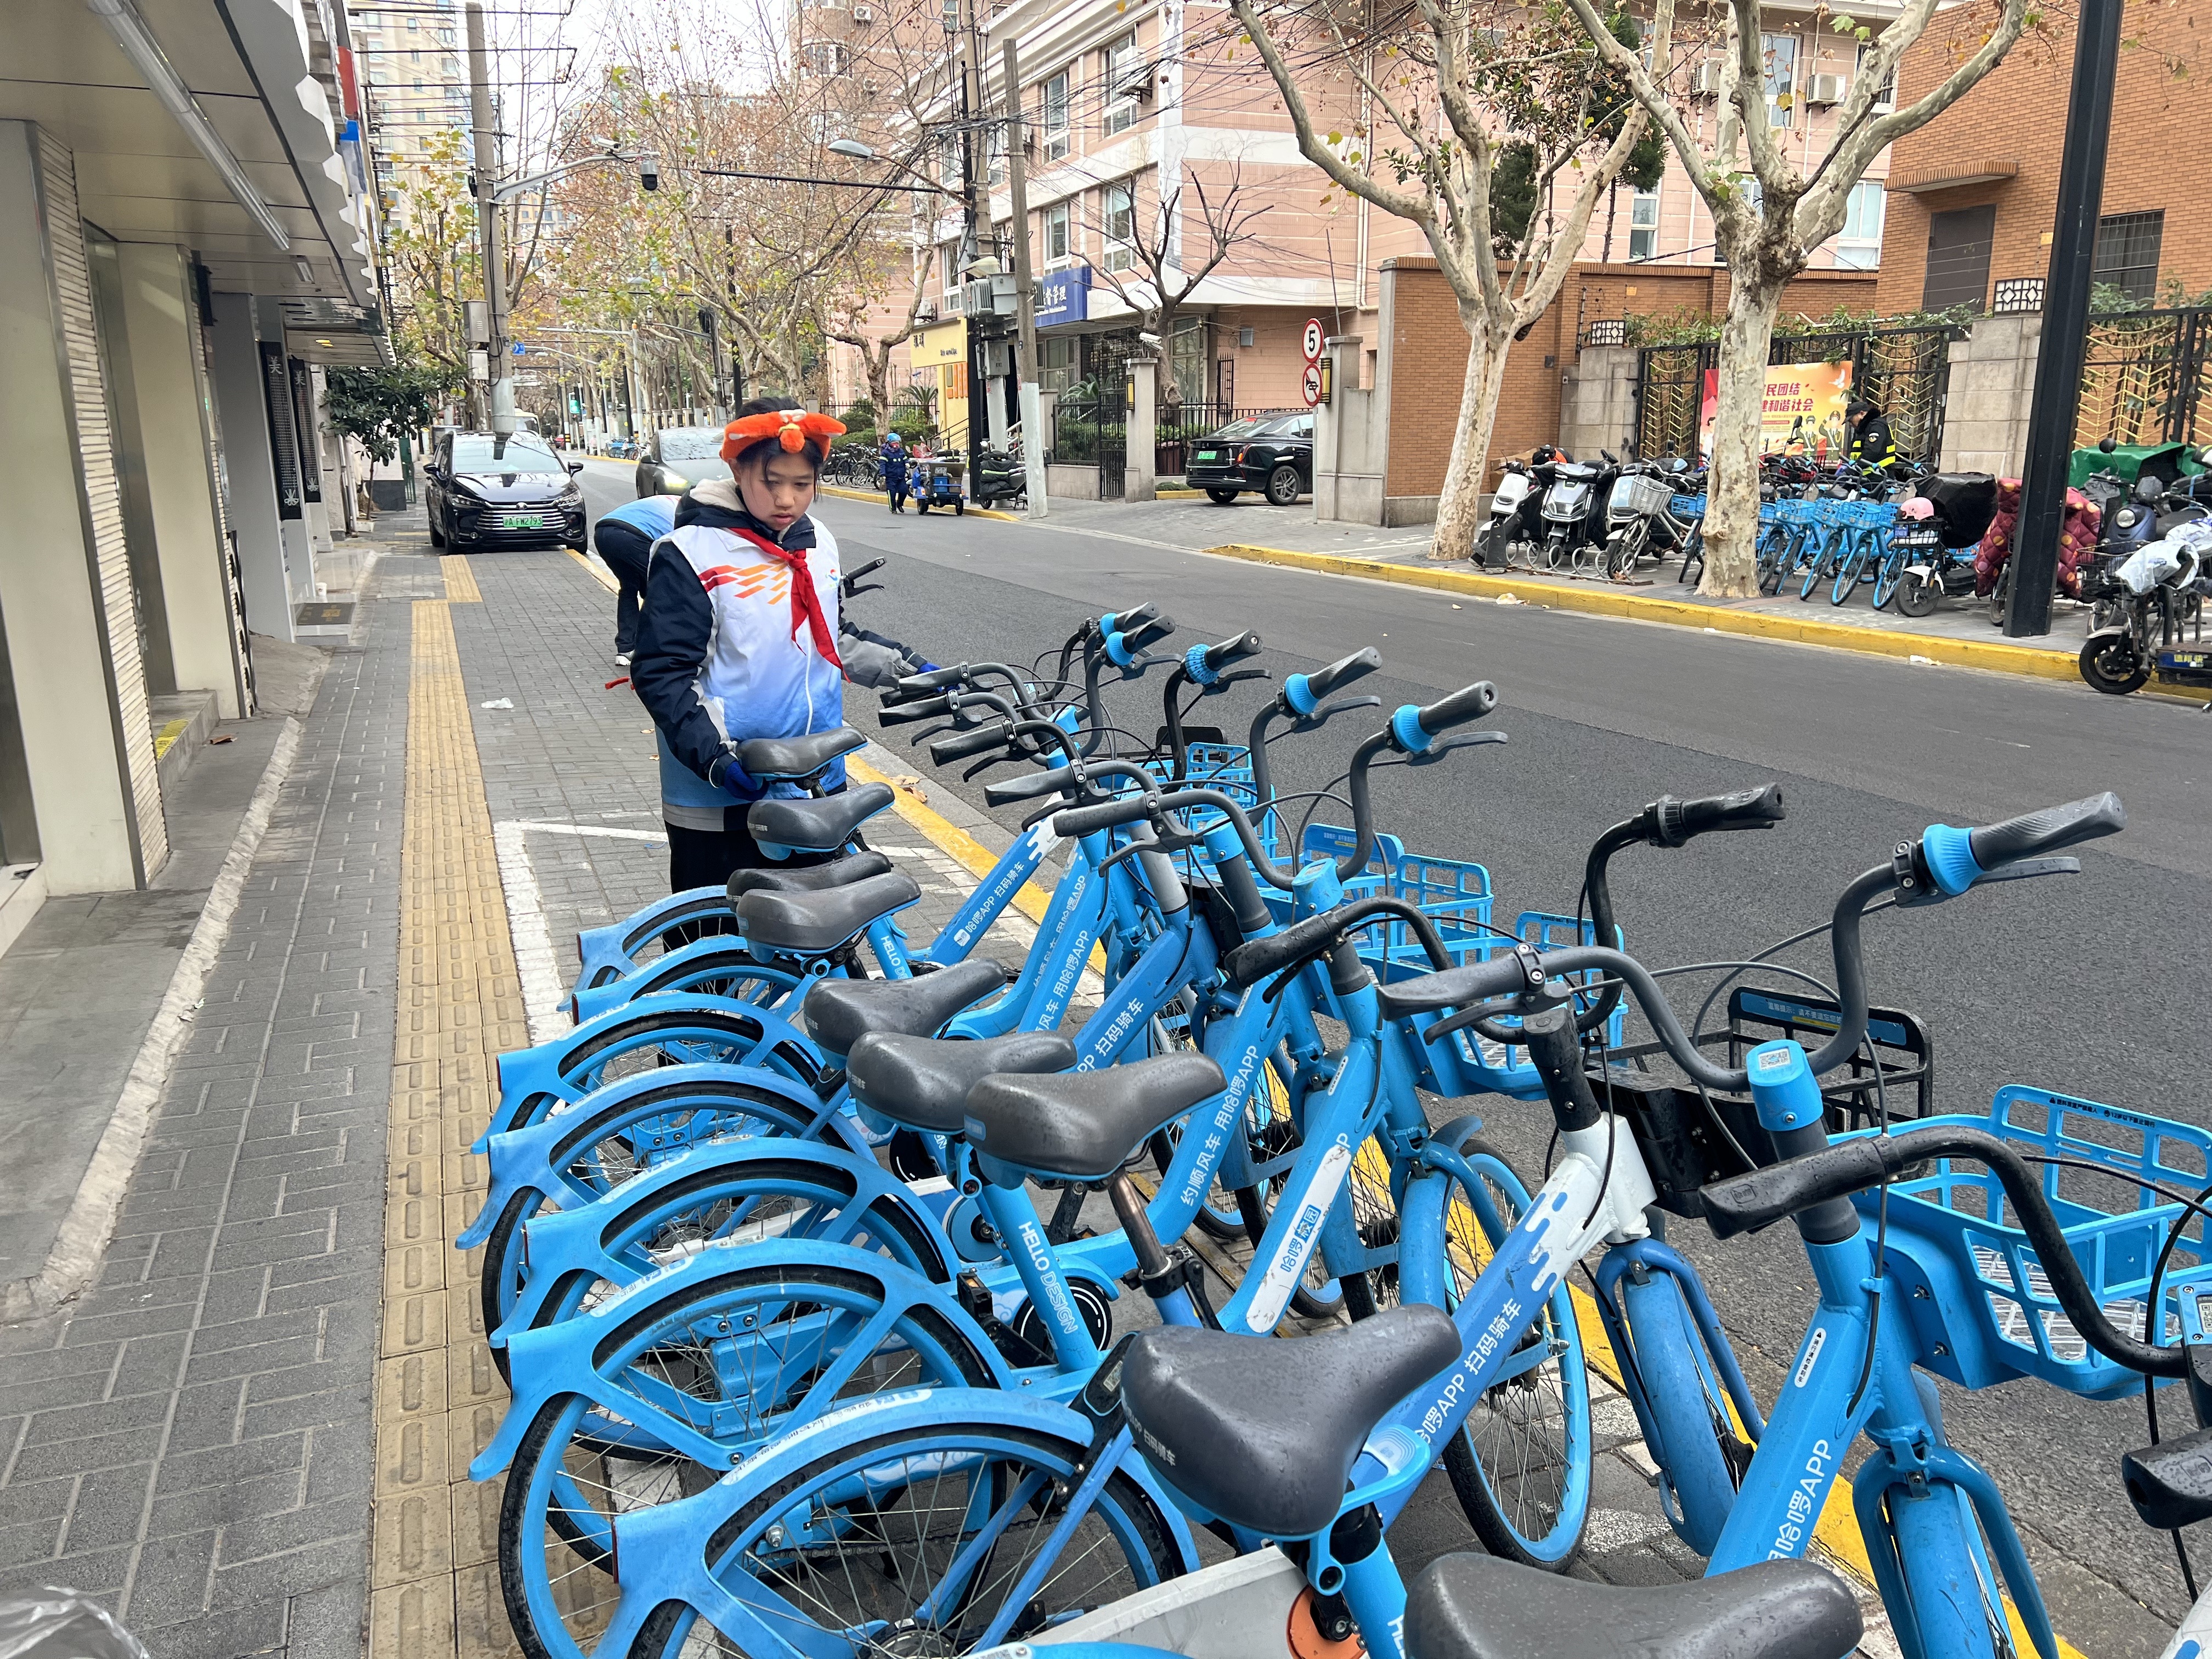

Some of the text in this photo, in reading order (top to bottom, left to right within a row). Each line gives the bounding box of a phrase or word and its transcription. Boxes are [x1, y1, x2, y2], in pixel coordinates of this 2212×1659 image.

[1043, 284, 1066, 306] 督管理
[1308, 330, 1315, 352] 5
[268, 356, 283, 375] 美
[294, 370, 306, 386] 美
[1764, 383, 1801, 396] 民团结
[994, 861, 1025, 898] 扫码骑车
[881, 935, 901, 967] HELLO
[1053, 930, 1090, 998] 用哈啰APP
[1094, 998, 1144, 1057] 扫码骑车
[1181, 1045, 1259, 1207] 约顺风车 用哈啰APP
[1018, 1221, 1079, 1335] HELLO DESIGN
[1464, 1297, 1521, 1375] 扫码骑车
